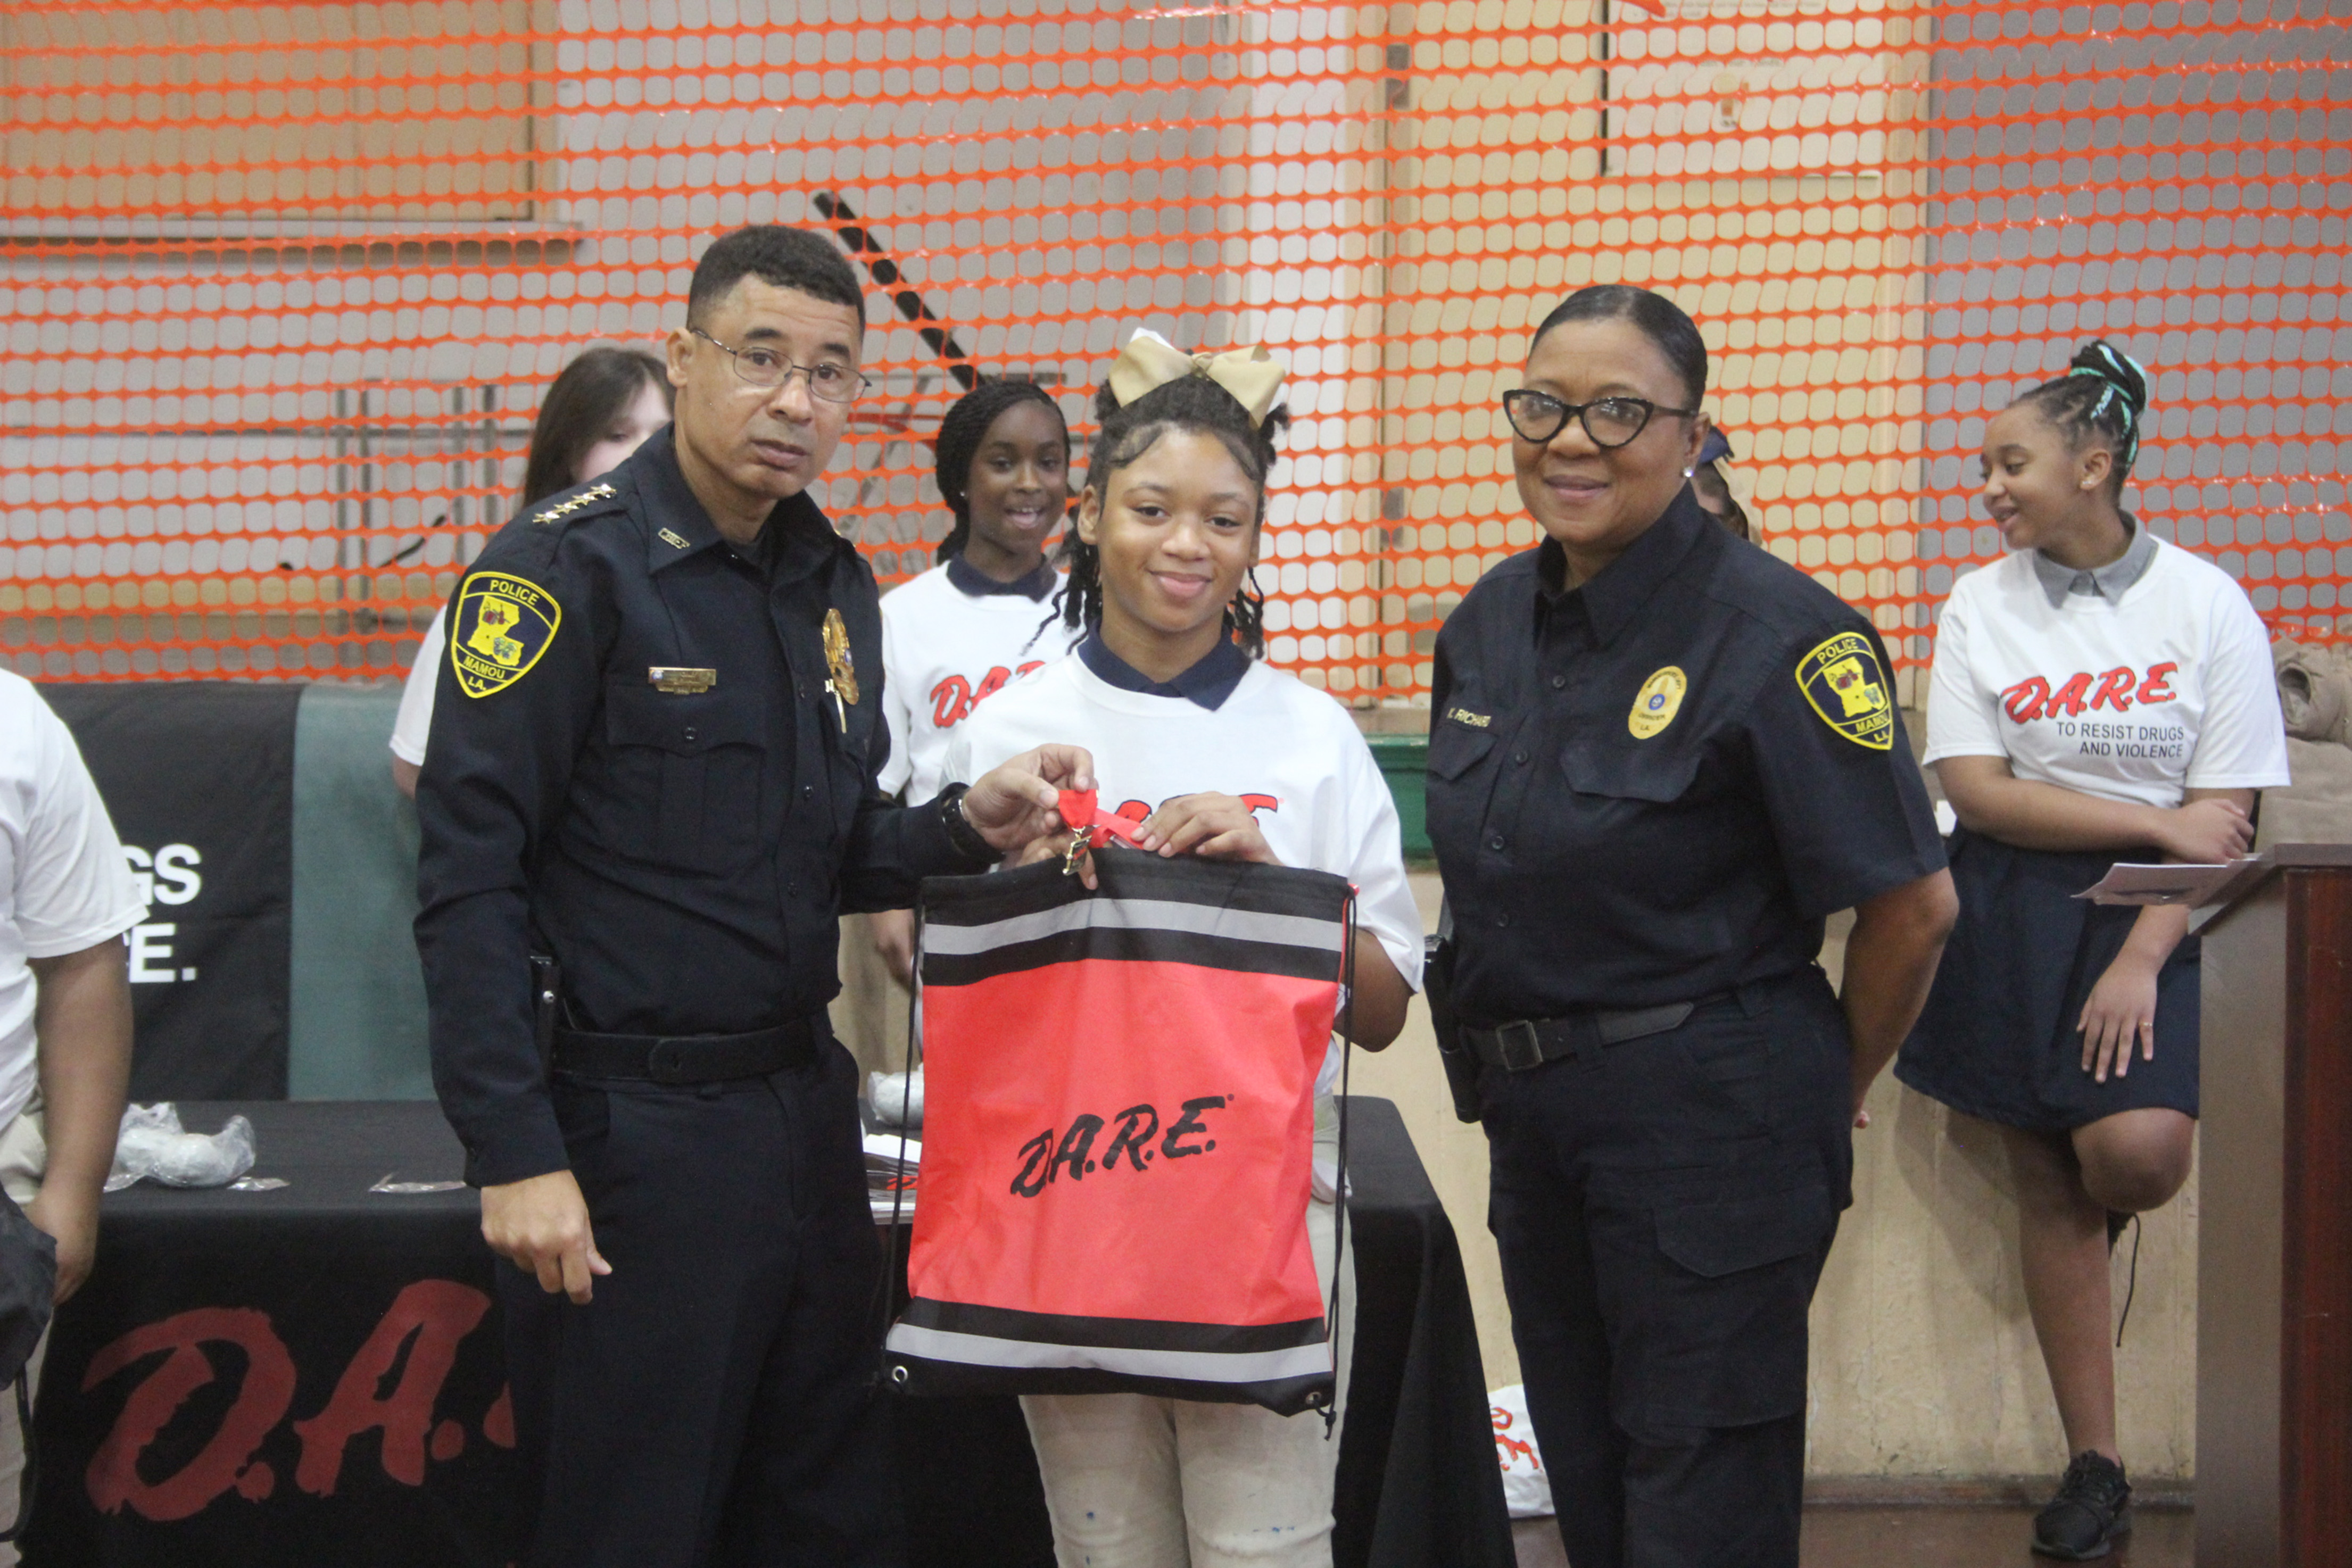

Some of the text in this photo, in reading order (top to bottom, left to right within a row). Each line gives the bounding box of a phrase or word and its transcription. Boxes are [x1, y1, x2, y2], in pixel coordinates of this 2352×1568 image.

[489, 579, 540, 606] POLICE
[1816, 638, 1859, 665] POLICE
[463, 655, 506, 680] MAMOU
[467, 676, 487, 691] LA.
[2001, 662, 2178, 724] D.A.R.E.
[2056, 721, 2184, 741] TO RESIST DRUGS
[2079, 743, 2183, 758] AND VIOLENCE
